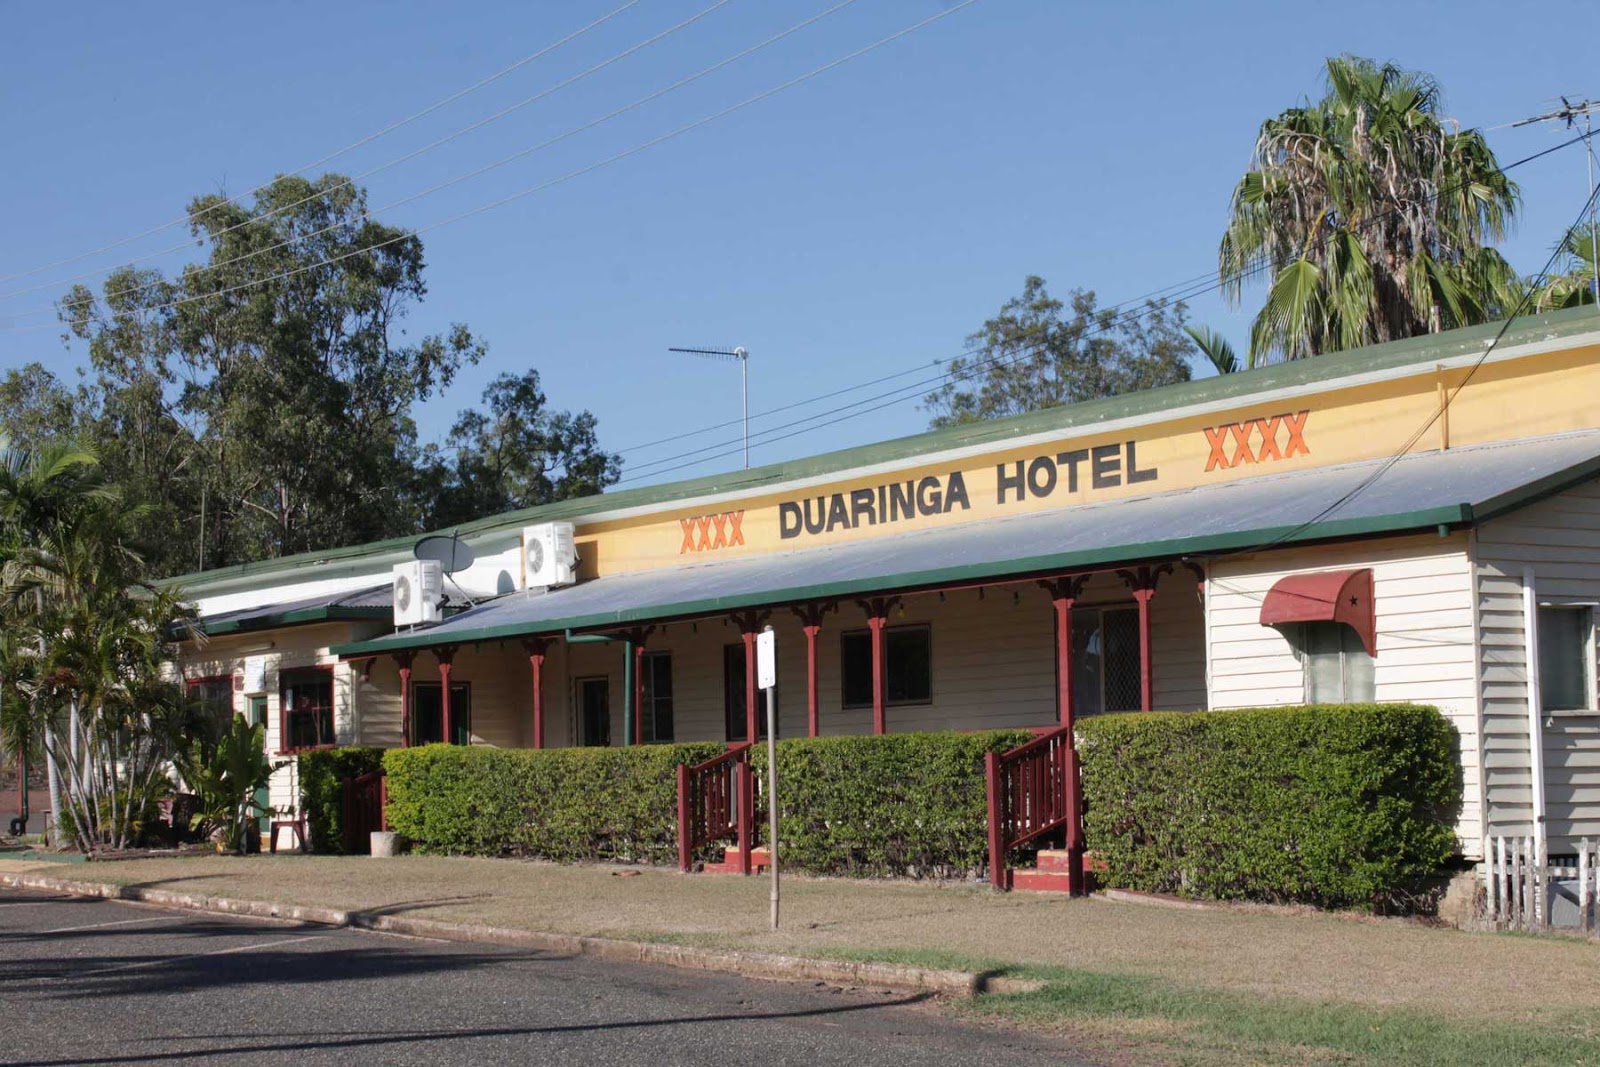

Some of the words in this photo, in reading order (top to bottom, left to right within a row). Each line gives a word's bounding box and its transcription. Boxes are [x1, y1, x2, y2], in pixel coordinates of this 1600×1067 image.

[1204, 410, 1309, 472] XXXX
[780, 472, 971, 539] DUARINGA
[997, 441, 1158, 504] HOTEL
[681, 511, 745, 555] XXXX
